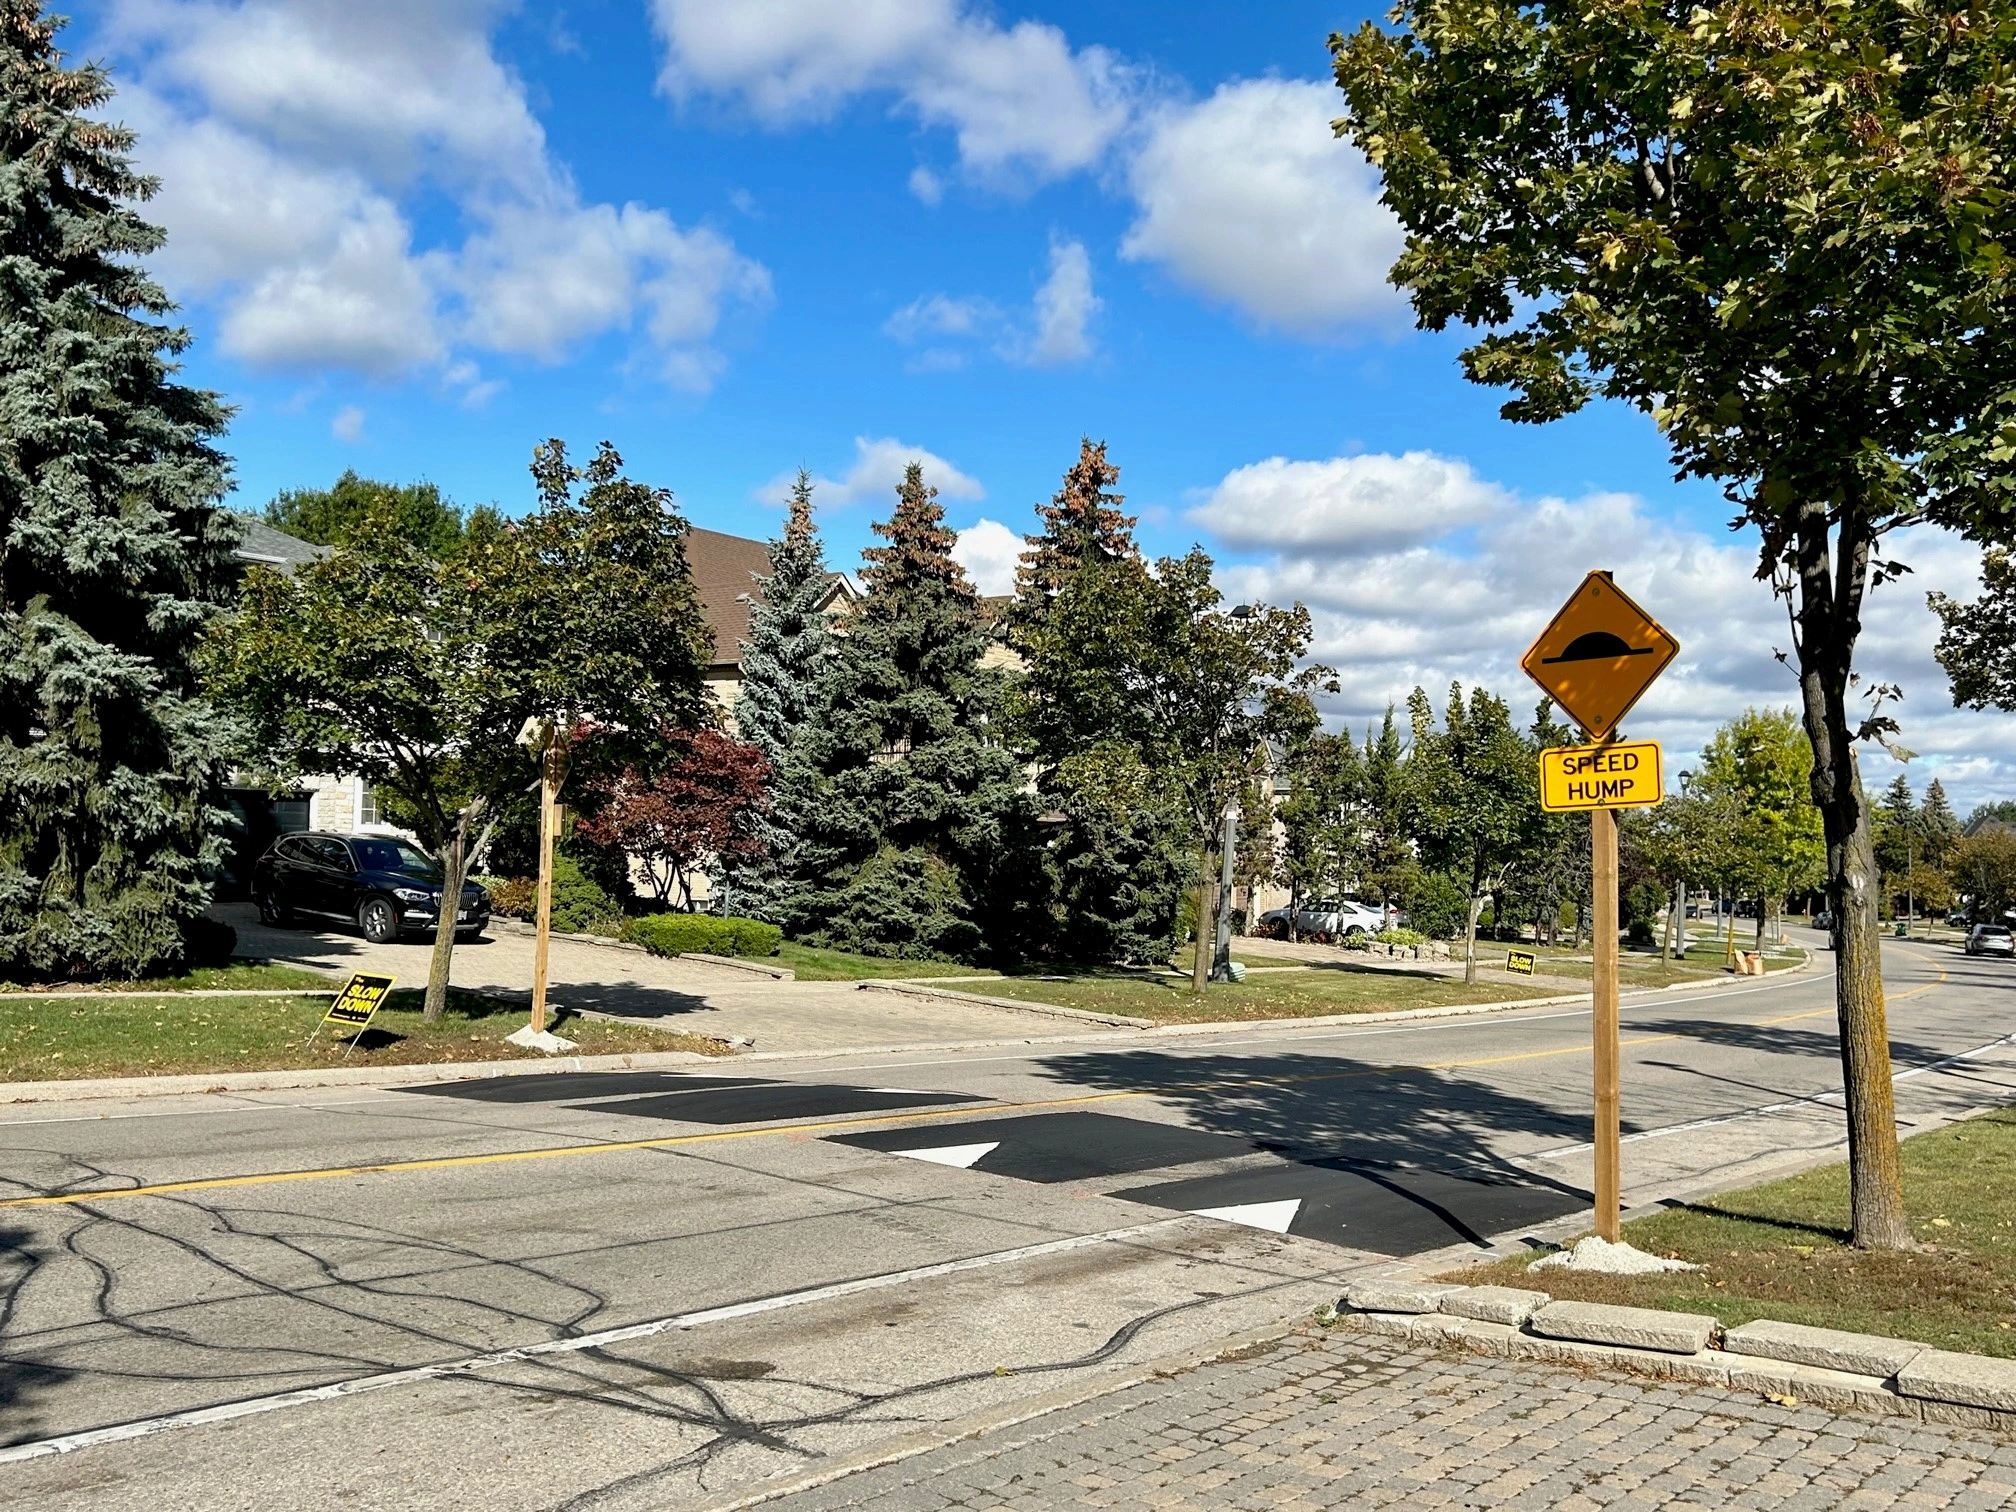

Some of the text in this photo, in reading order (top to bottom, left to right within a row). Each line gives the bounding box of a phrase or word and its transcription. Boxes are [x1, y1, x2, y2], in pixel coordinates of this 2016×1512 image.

[1563, 753, 1639, 775] SPEED
[1568, 779, 1634, 800] HUMP
[1508, 961, 1531, 971] DOWN
[1510, 955, 1532, 965] SLOW
[347, 984, 385, 1000] SLOW
[337, 996, 376, 1014] DOWN
